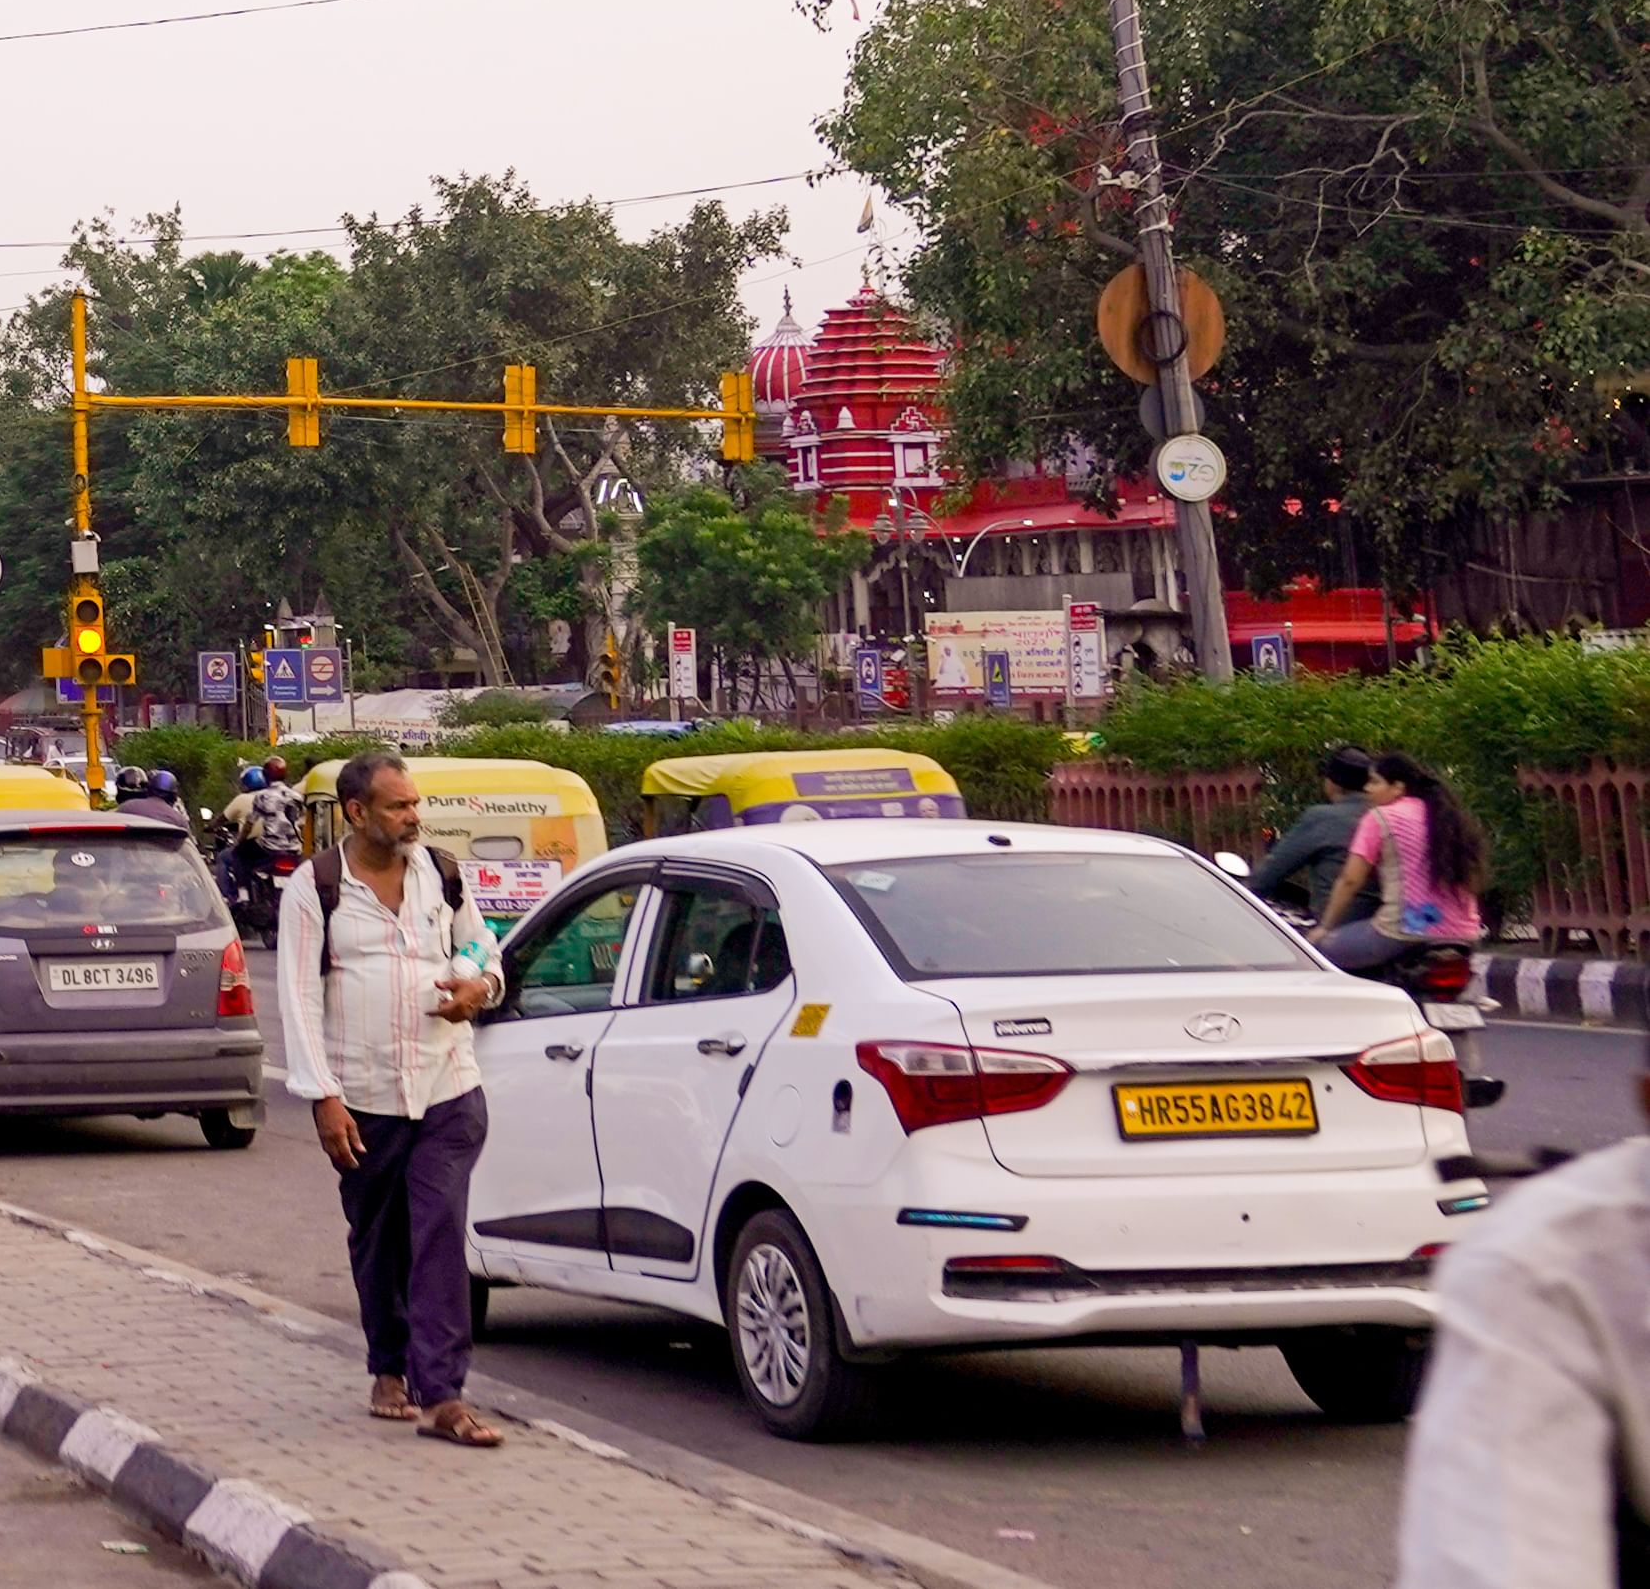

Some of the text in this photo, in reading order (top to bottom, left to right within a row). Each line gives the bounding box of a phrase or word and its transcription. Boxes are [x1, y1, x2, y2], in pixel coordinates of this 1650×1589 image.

[427, 795, 466, 808] Pure
[484, 802, 548, 817] Healthy
[62, 967, 155, 987] DL 8CT 3496
[1137, 1092, 1311, 1127] HR55AG3842
